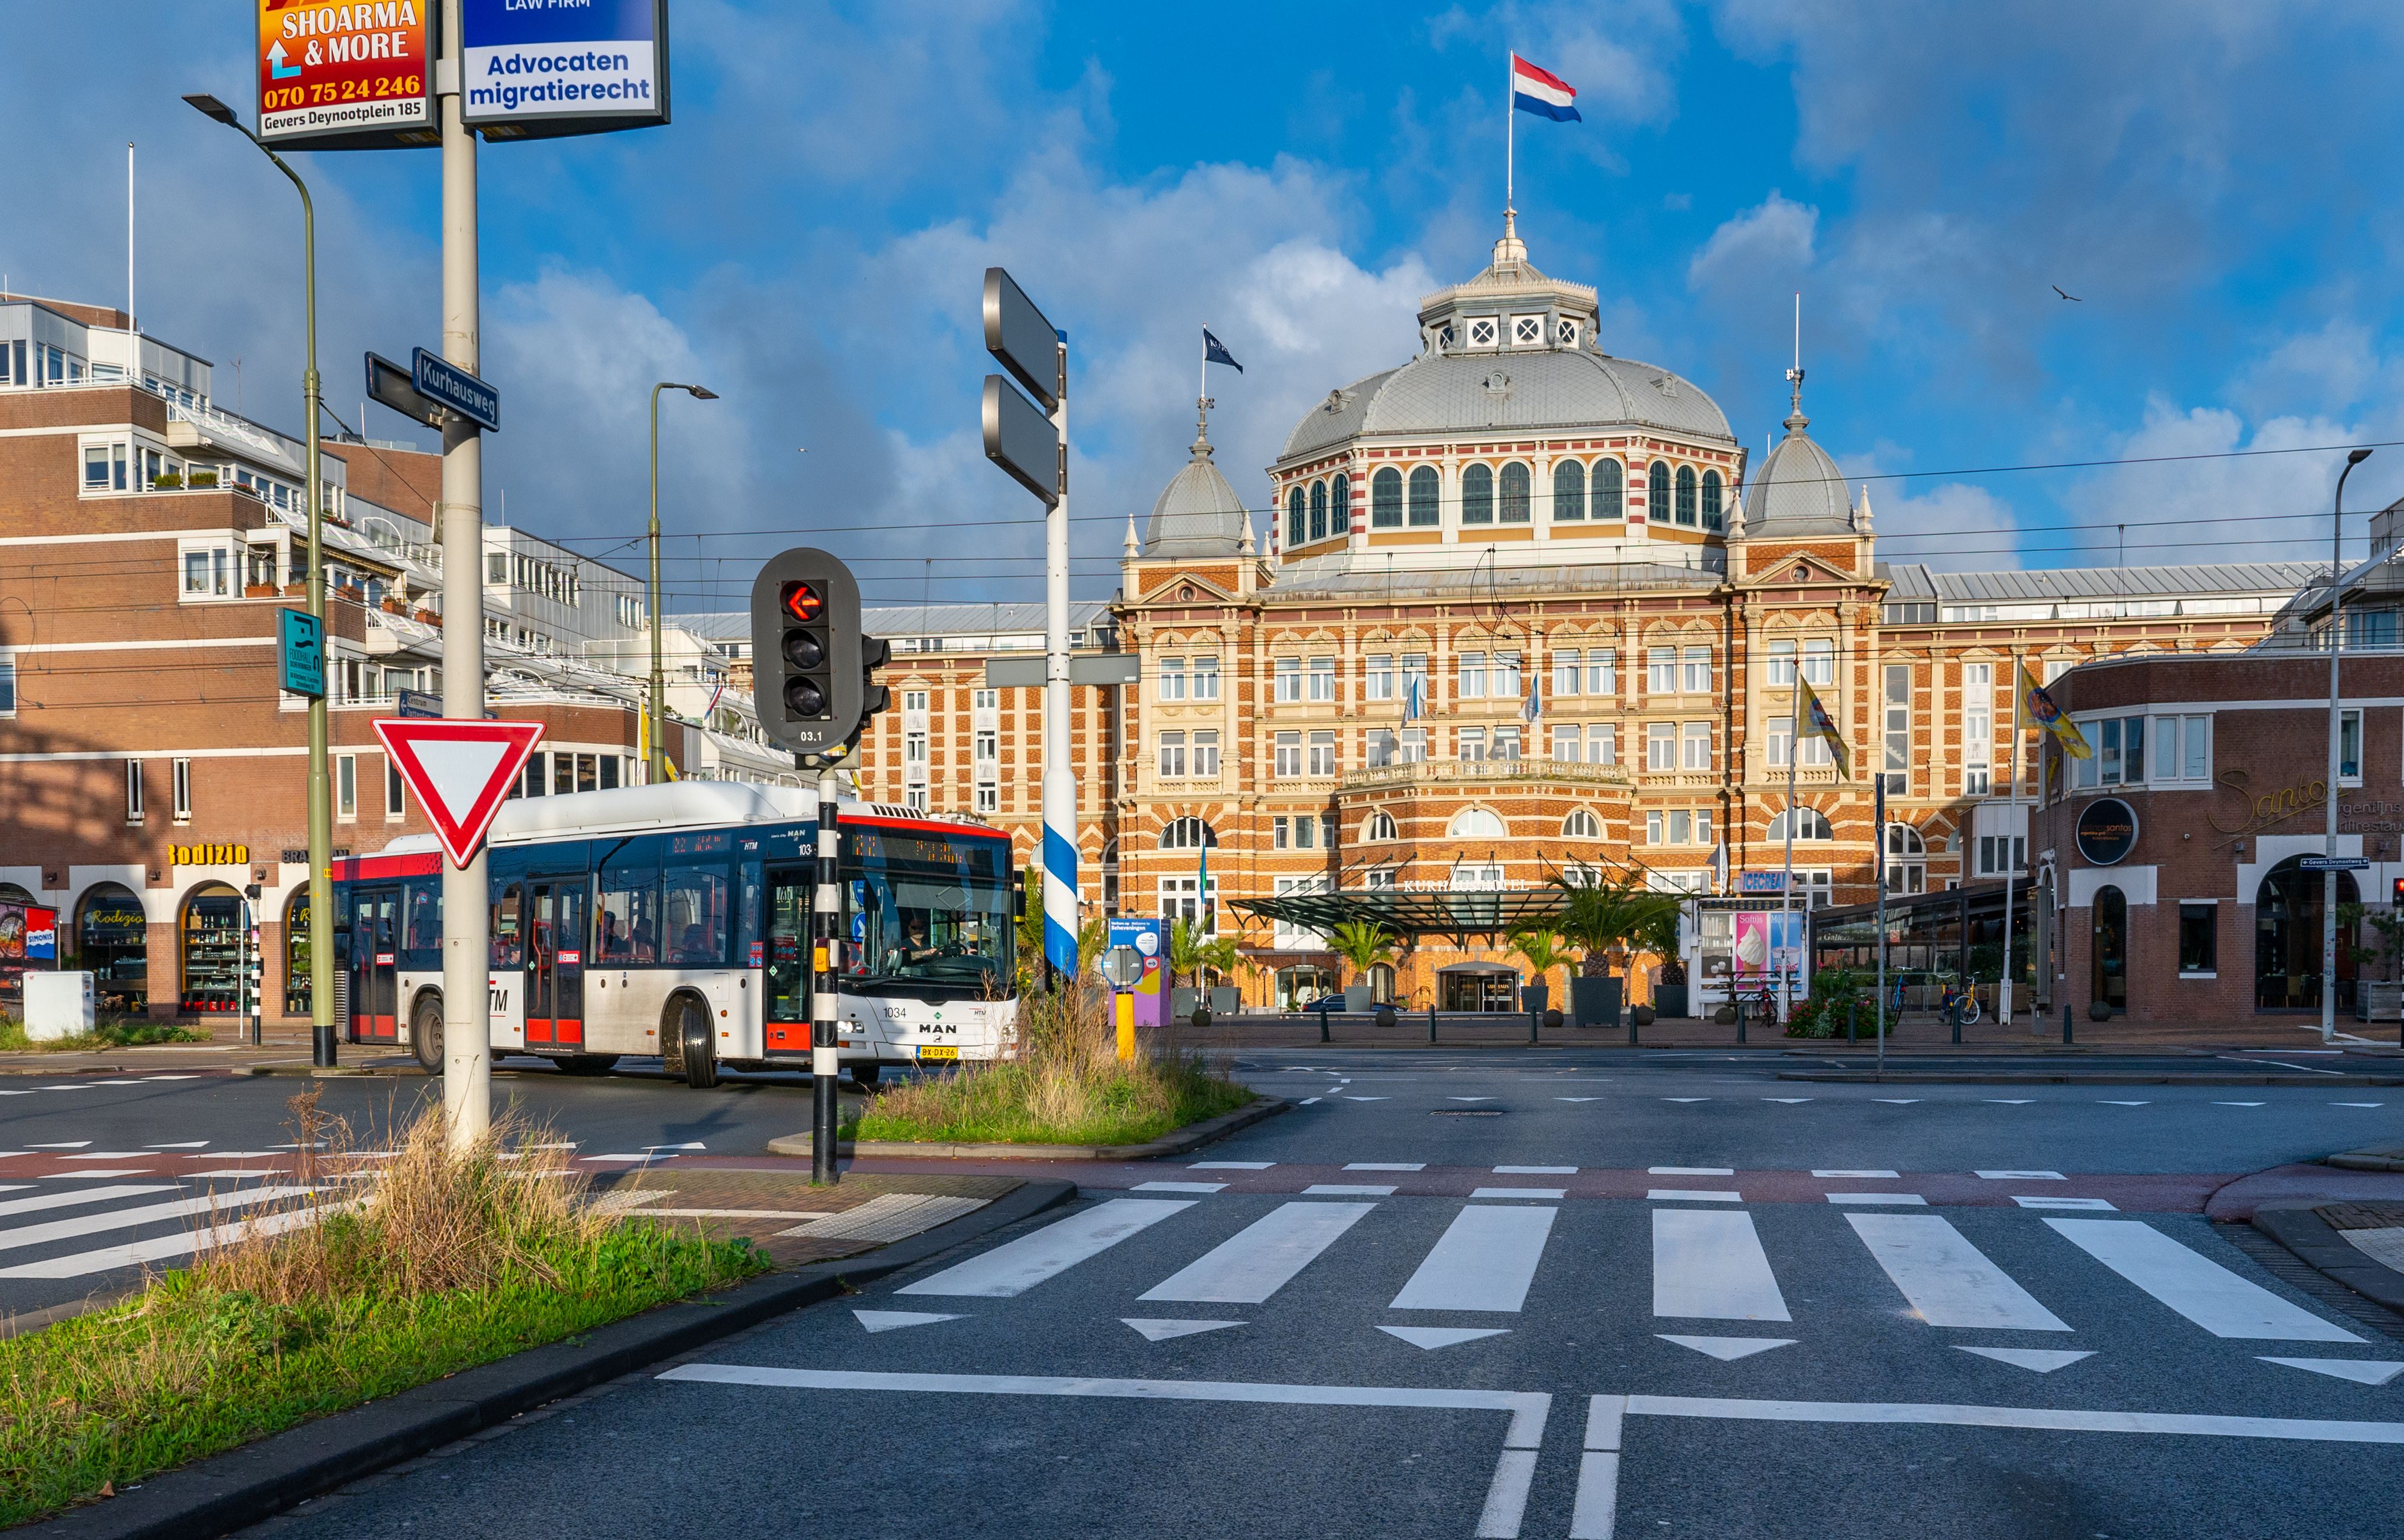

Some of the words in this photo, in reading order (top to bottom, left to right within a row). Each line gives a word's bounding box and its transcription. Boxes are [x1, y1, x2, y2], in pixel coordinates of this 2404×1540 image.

[505, 0, 542, 11] LAW
[548, 0, 590, 9] FIRM
[282, 1, 417, 40] SHOARMA
[304, 39, 323, 67] &
[329, 31, 409, 64] MORE
[487, 52, 629, 75] Advocaten
[264, 86, 304, 109] 070
[310, 82, 337, 103] 75
[341, 79, 370, 100] 24
[375, 75, 421, 97] 246
[470, 78, 651, 110] migratierecht
[265, 115, 306, 130] Gevers
[308, 104, 395, 125] Deynootplein
[398, 102, 421, 116] 185
[423, 359, 495, 422] Kurhausweg
[290, 648, 311, 664] FOODHALL
[408, 695, 427, 707] Centrum
[800, 731, 822, 742] 03.1
[744, 842, 758, 851] HTM
[799, 844, 813, 856] 103
[168, 843, 248, 865] Rodizio
[1403, 879, 1479, 892] KURHAUS
[1480, 879, 1530, 891] HOTEL
[91, 909, 144, 927] Rodizio
[1739, 915, 1763, 924] Softijs
[28, 933, 53, 943] SIMONIS
[884, 1007, 907, 1017] 1034
[919, 1024, 957, 1033] MAN
[922, 1048, 955, 1056] BX-DX-26
